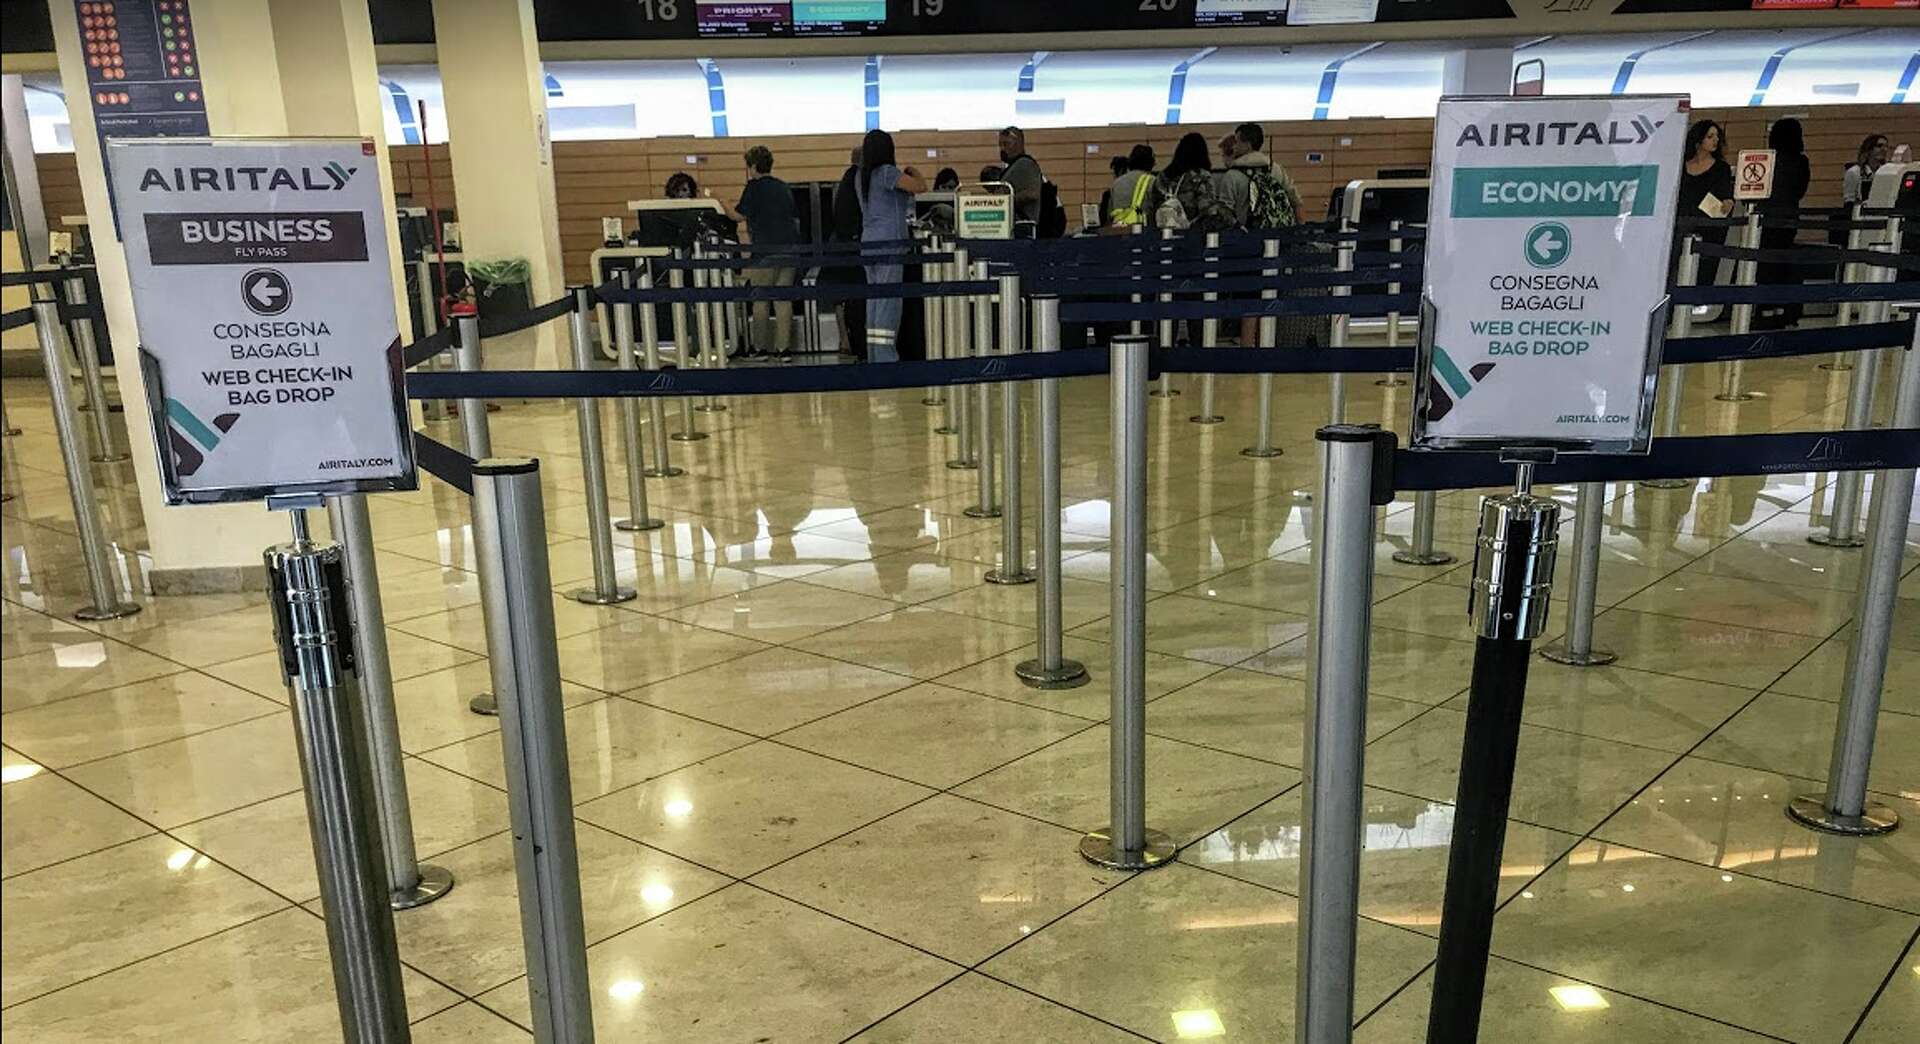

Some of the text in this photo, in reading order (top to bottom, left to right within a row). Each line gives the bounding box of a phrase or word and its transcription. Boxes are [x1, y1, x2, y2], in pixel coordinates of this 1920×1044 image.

[638, 0, 678, 21] 18
[714, 7, 774, 15] PRIORITY
[1456, 115, 1665, 147] AIRITALY
[139, 161, 358, 192] AIRITALY
[1482, 179, 1627, 203] ECONOMY
[964, 199, 1004, 207] AIRITALY
[181, 219, 334, 244] BUSINESS
[235, 247, 288, 257] FLY PASS
[1490, 275, 1599, 290] CONSEGNA
[1501, 296, 1584, 310] BAGAGLI
[213, 322, 331, 339] CONSEGNA
[1470, 321, 1611, 335] WEB CHECK-IN
[231, 342, 320, 359] BAGAGLI
[1488, 341, 1589, 355] BAG DROP
[202, 366, 353, 385] WEB CHECK-IN
[228, 387, 335, 405] BAG DROP
[1556, 415, 1630, 423] AIRITALY.COM
[318, 458, 393, 470] AIRITALY.COM
